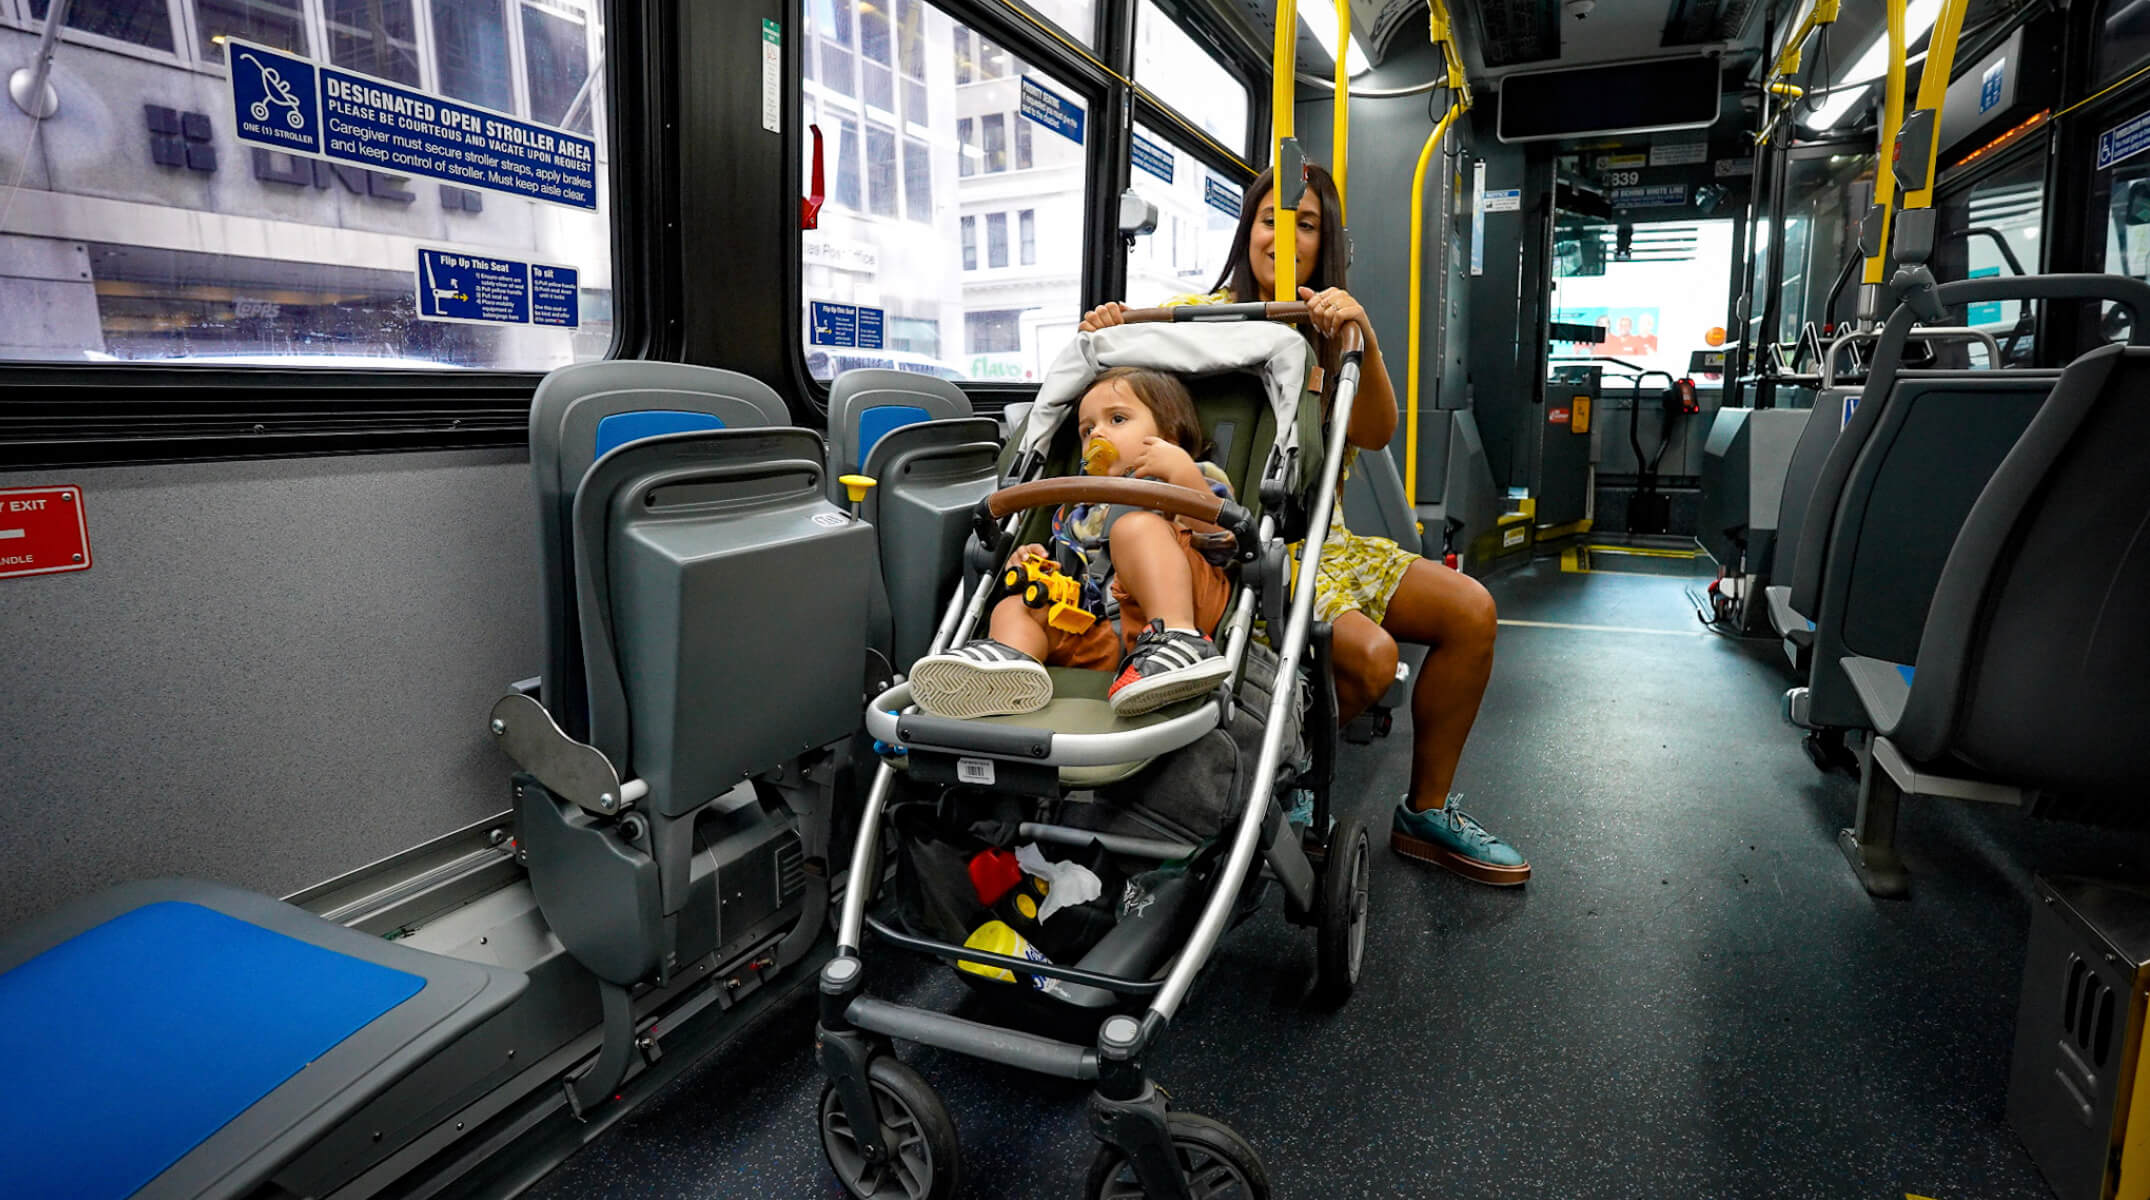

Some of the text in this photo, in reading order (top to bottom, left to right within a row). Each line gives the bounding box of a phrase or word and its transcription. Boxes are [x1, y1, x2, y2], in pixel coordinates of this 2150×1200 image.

[327, 77, 592, 162] DESIGNATED OPEN STROLLER AREA
[243, 121, 314, 145] ONE (1) STROLLER
[328, 99, 592, 173] PLEASE BE COURTEOUS AND VACATE UPON REQUEST
[329, 118, 592, 189] Caregiver must secure stroller straps, apply brakes
[330, 138, 586, 202] and keep control of stroller. Must keep aisle clear.
[1602, 171, 1639, 187] 839
[440, 255, 509, 273] Flip Up This Seat
[533, 267, 554, 279] To sit
[9, 499, 48, 512] EXIT
[0, 554, 33, 565] NDLE
